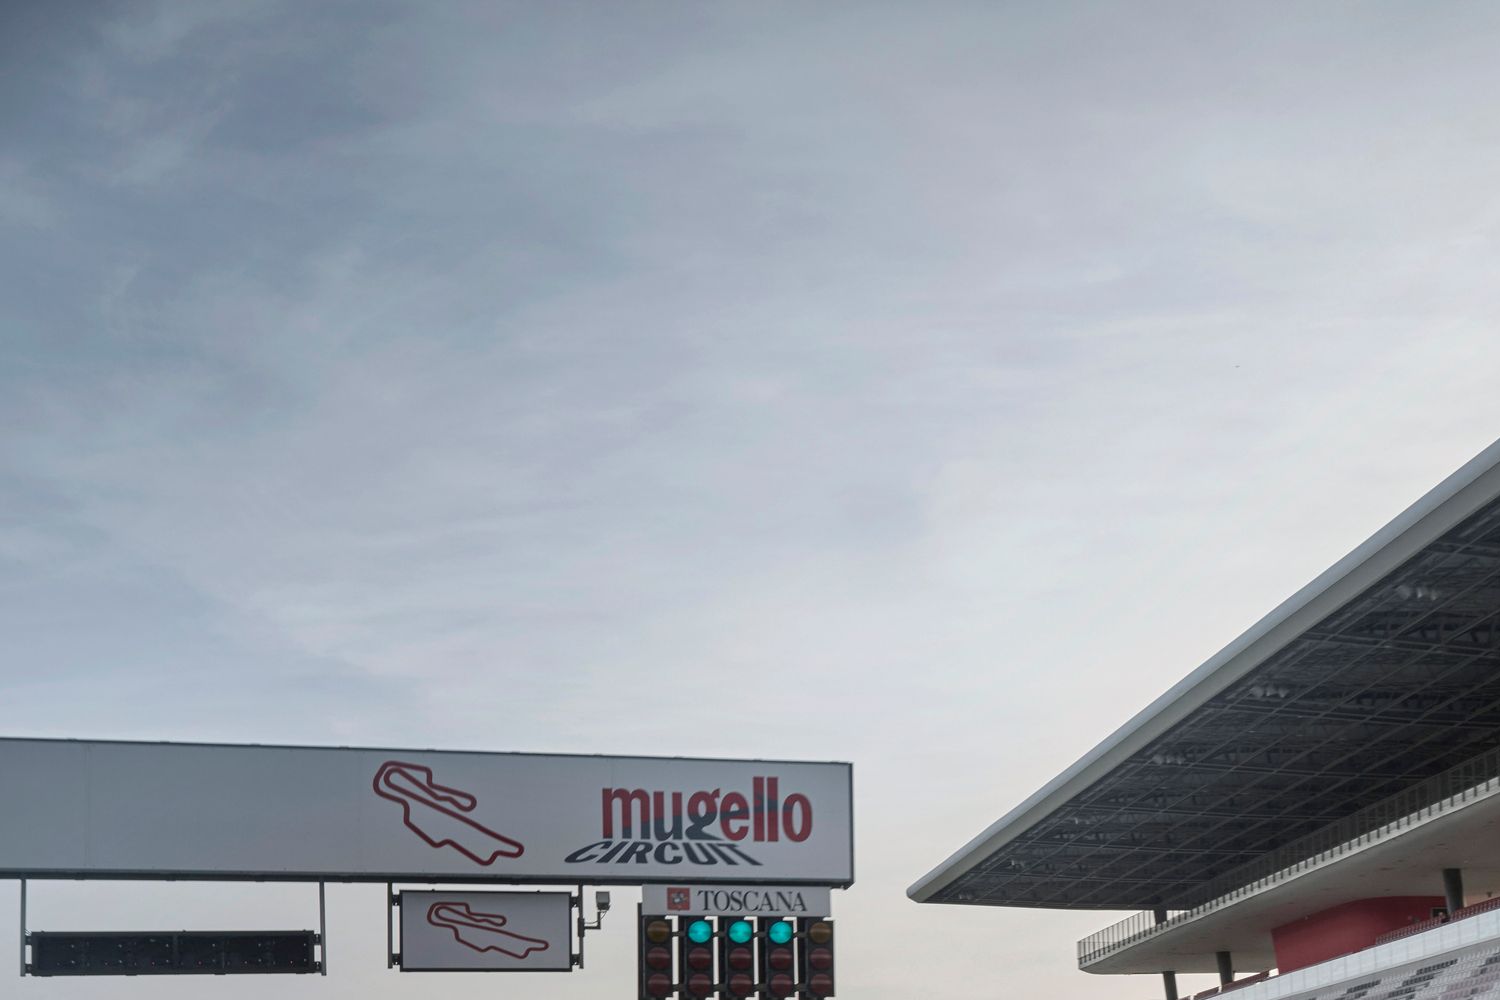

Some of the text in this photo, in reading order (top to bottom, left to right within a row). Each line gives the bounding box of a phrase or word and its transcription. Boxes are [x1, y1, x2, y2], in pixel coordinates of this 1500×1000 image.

[602, 776, 813, 842] mugello
[564, 841, 763, 866] CIRCUIT
[697, 889, 808, 912] TOSCANA
